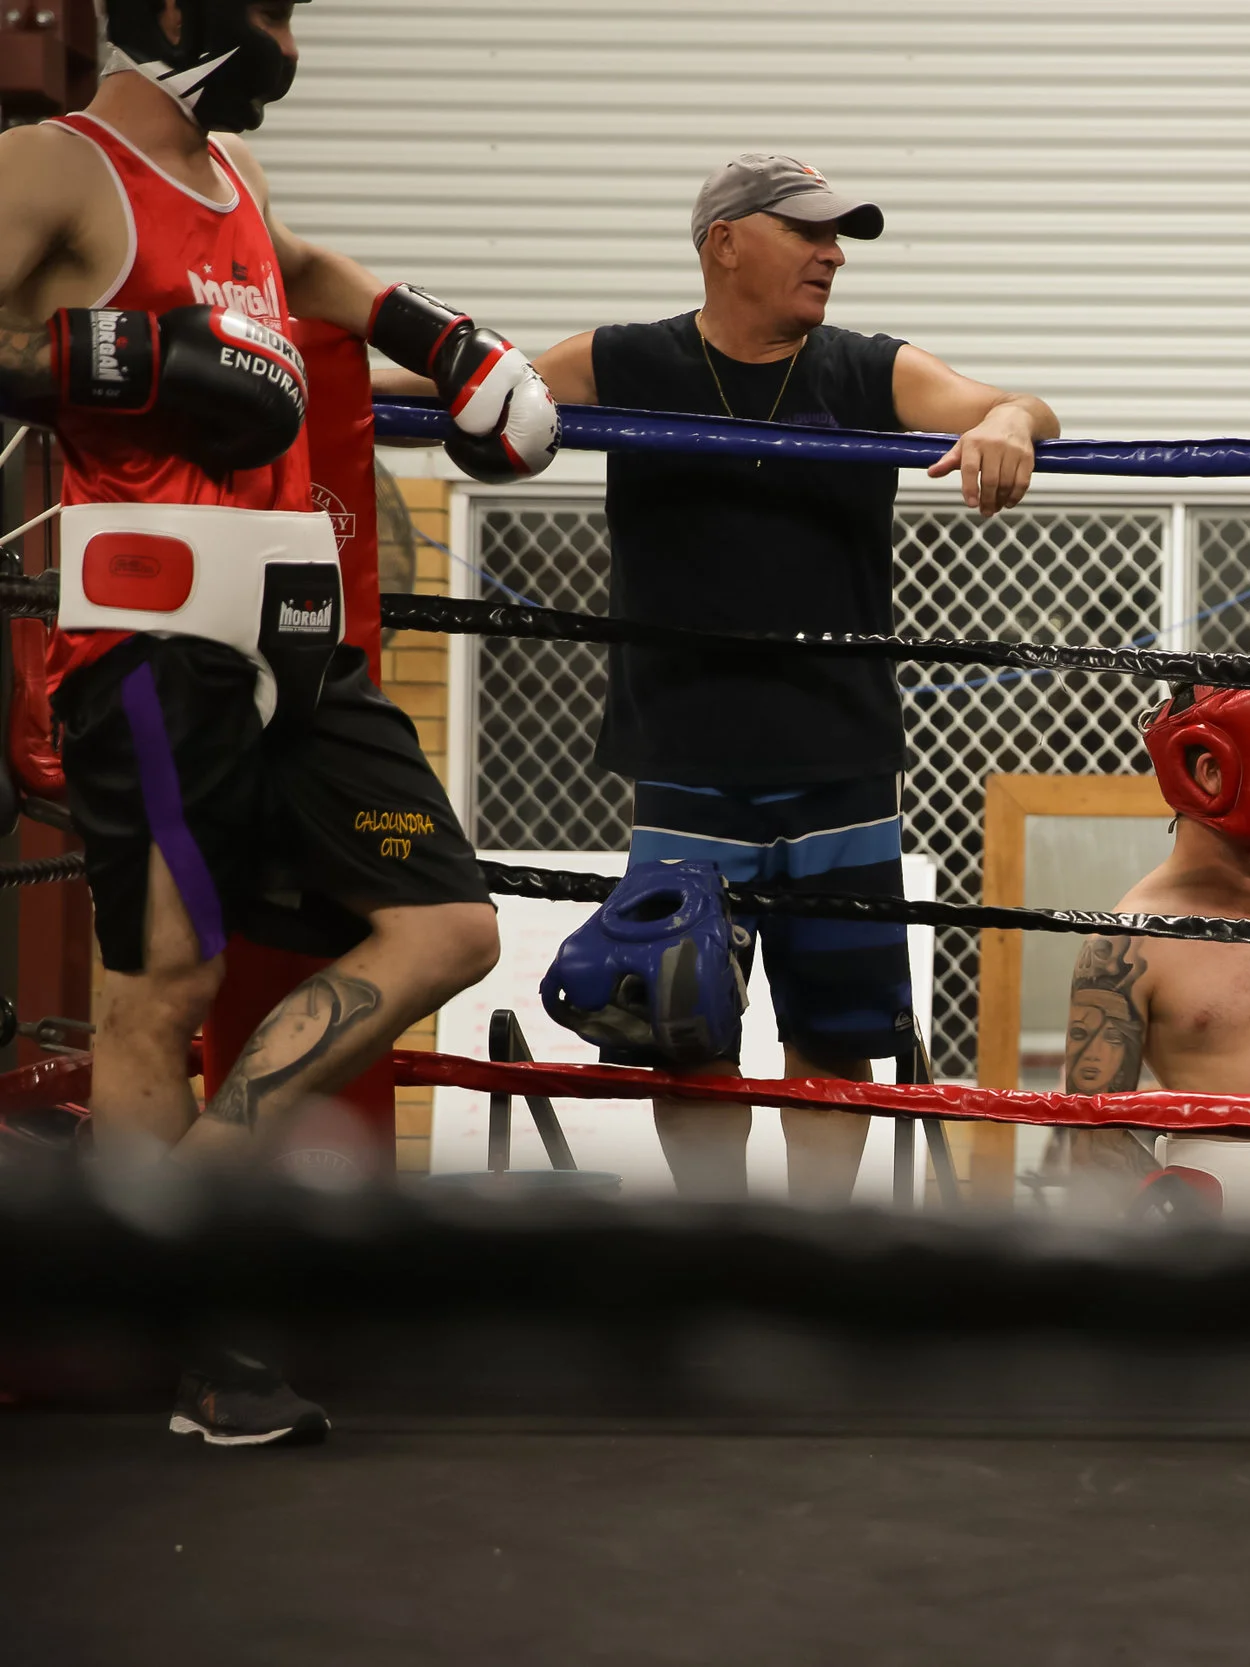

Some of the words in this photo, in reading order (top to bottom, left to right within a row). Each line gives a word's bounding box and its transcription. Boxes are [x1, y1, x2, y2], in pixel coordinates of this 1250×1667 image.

[98, 311, 125, 381] MORGAN
[220, 347, 306, 418] ENDURAN
[279, 601, 332, 626] MORGAN
[355, 810, 435, 834] CALOUNDRA
[381, 837, 411, 859] CITY
